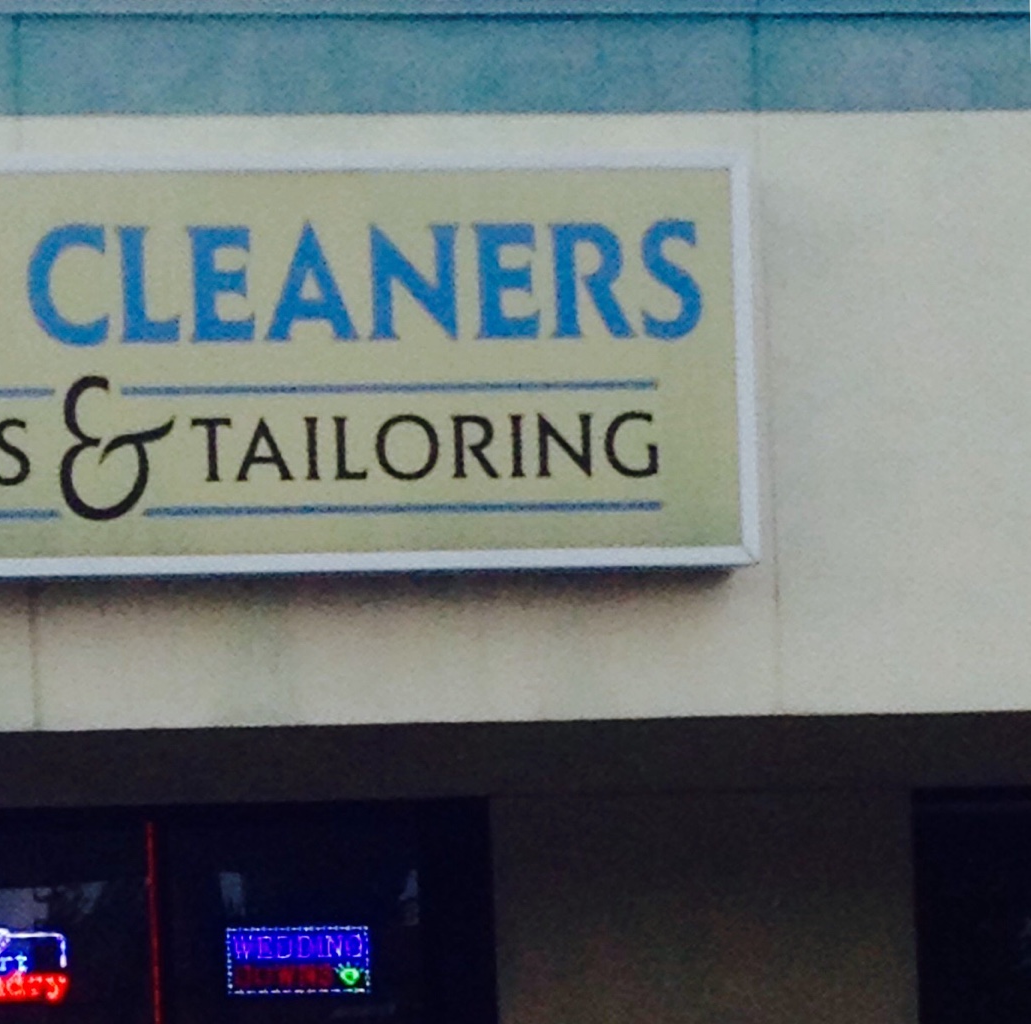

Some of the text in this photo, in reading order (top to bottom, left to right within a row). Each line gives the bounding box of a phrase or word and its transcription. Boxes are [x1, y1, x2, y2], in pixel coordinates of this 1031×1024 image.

[27, 218, 704, 346] CLEANERS
[58, 375, 174, 521] &
[190, 411, 660, 482] TAILORING
[233, 934, 363, 959] WEDDING
